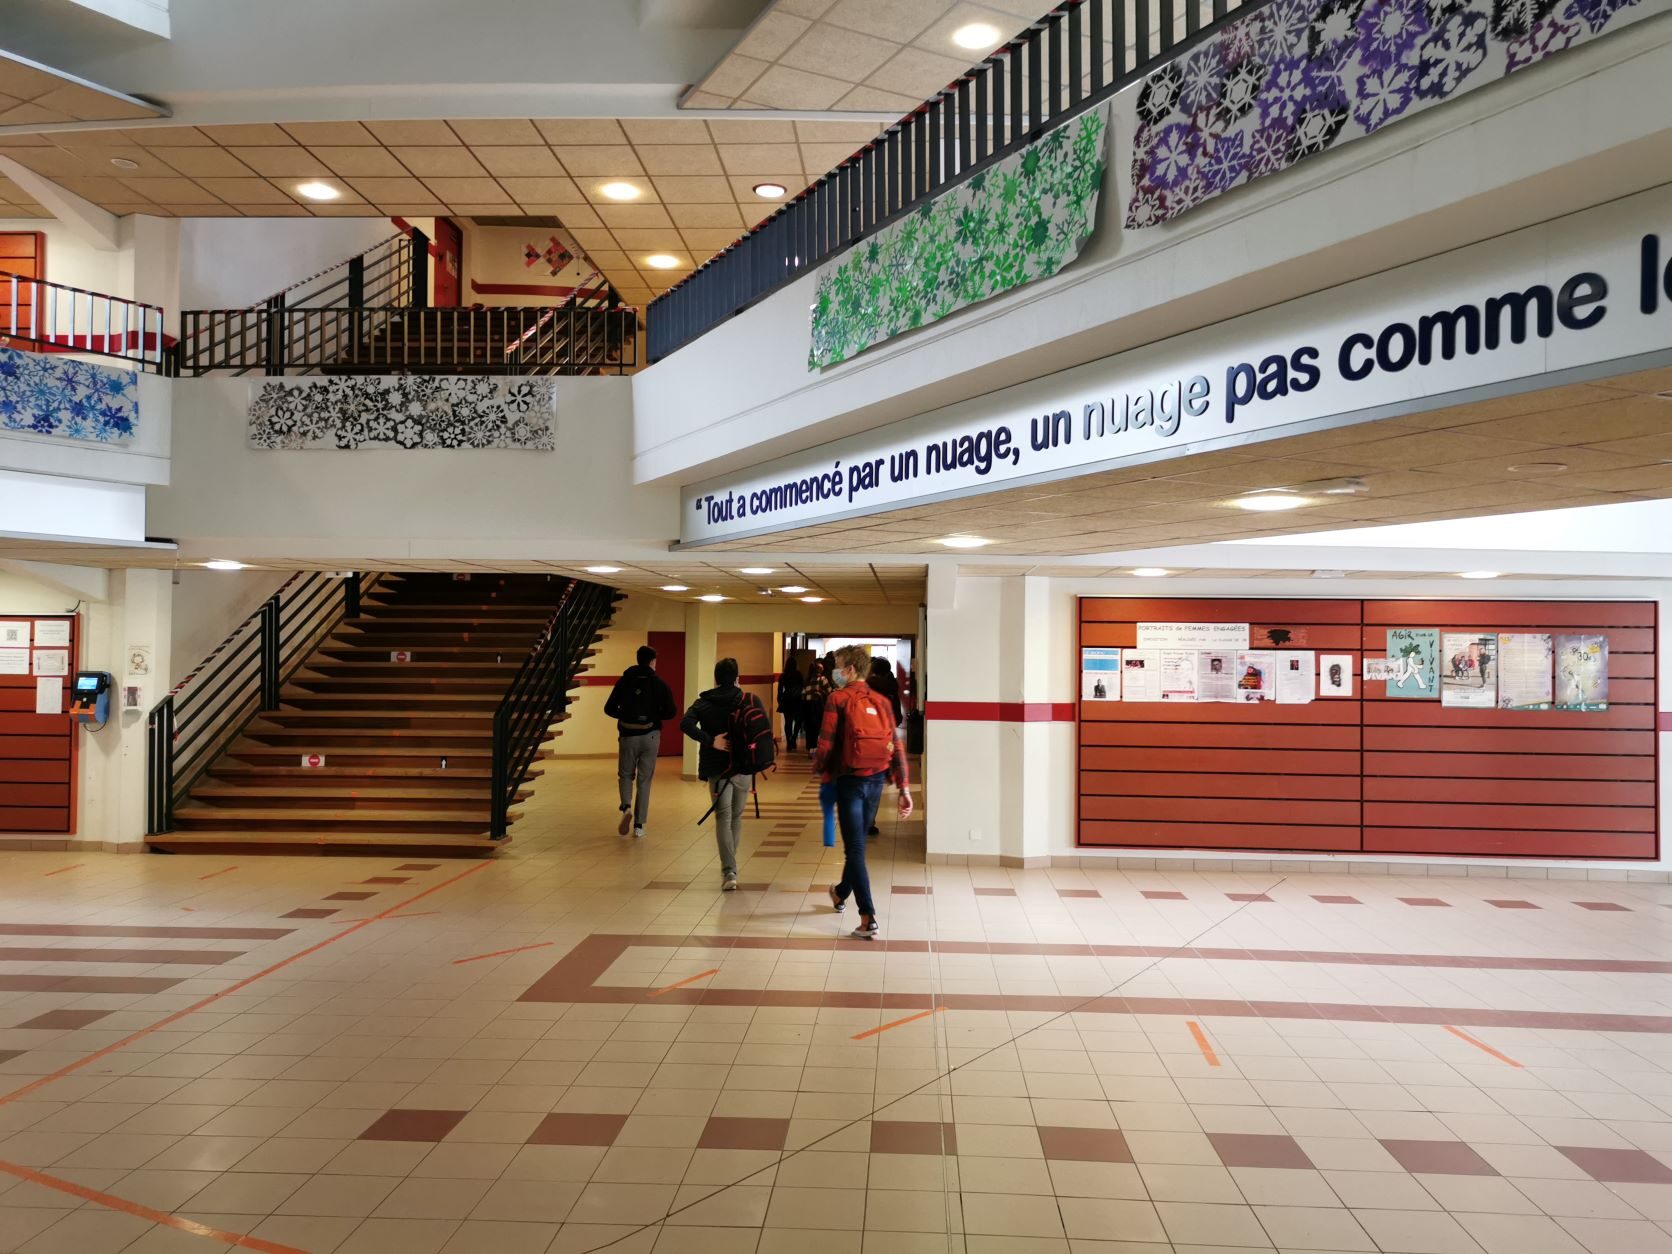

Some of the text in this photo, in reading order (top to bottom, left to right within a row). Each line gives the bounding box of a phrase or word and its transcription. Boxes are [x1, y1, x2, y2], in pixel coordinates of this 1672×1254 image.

[737, 498, 746, 518] a
[750, 460, 843, 516] commencé
[848, 458, 885, 503] par
[890, 447, 918, 483] un
[926, 426, 1020, 476] nuage,
[1031, 410, 1071, 452] un
[1083, 374, 1210, 438] nuage
[1225, 346, 1322, 424] pas
[1338, 272, 1608, 381] comme
